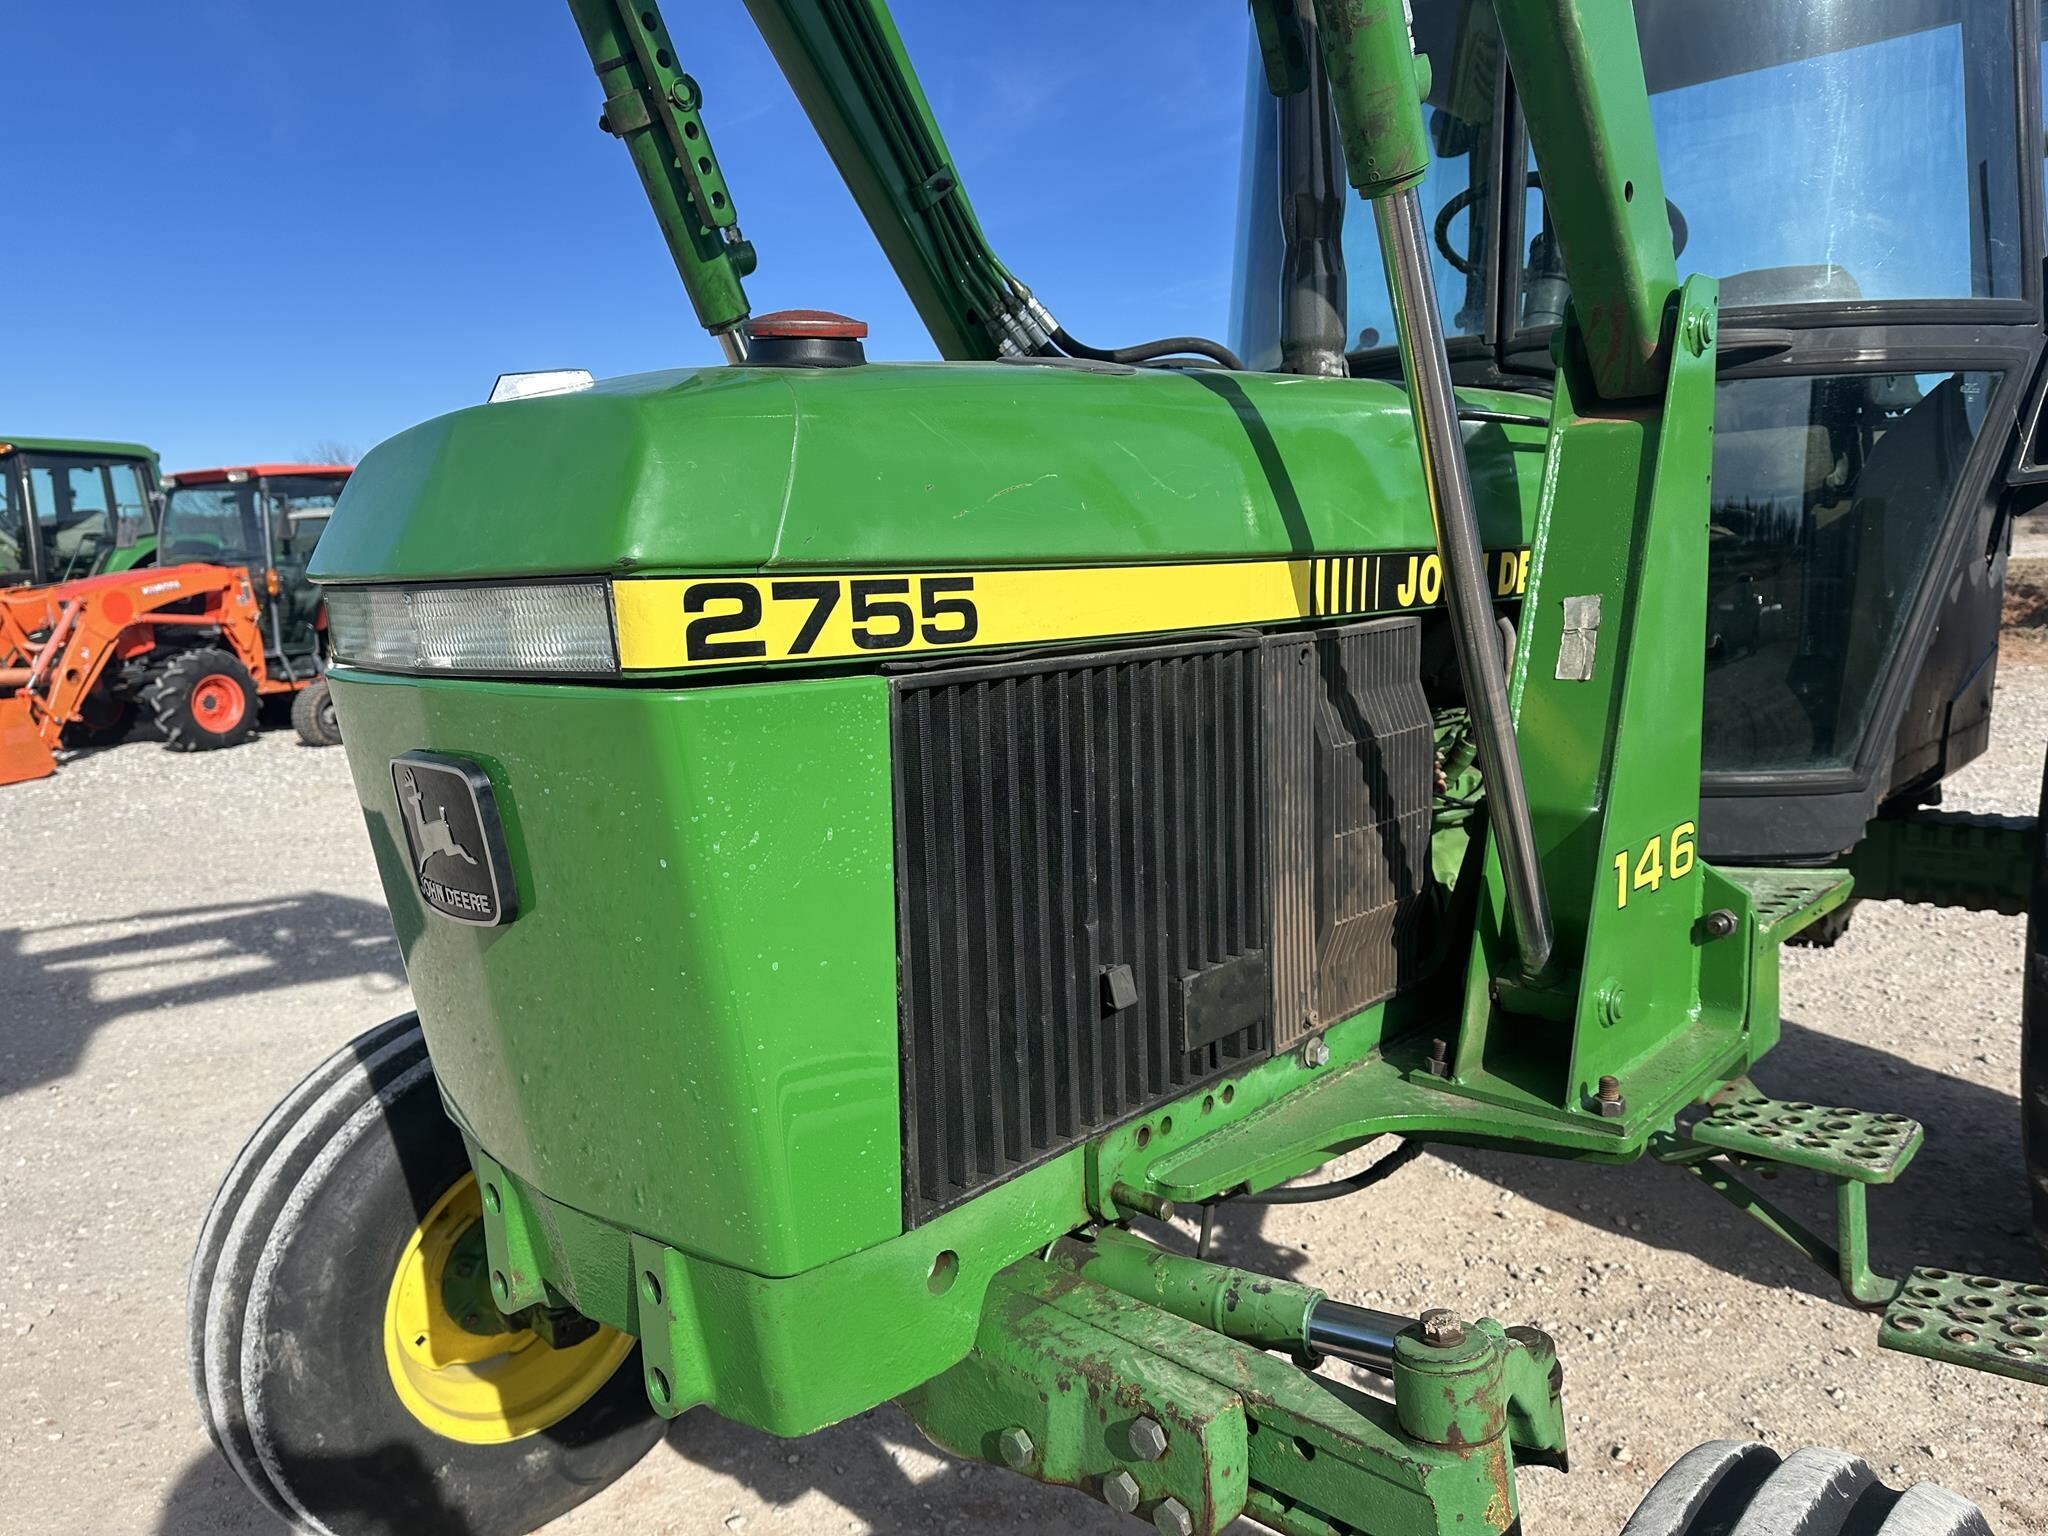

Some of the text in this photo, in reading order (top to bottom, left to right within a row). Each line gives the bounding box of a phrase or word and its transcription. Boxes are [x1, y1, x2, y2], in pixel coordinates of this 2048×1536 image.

[683, 576, 978, 661] 2755
[445, 887, 491, 914] DEERE
[1613, 820, 1696, 911] 146
